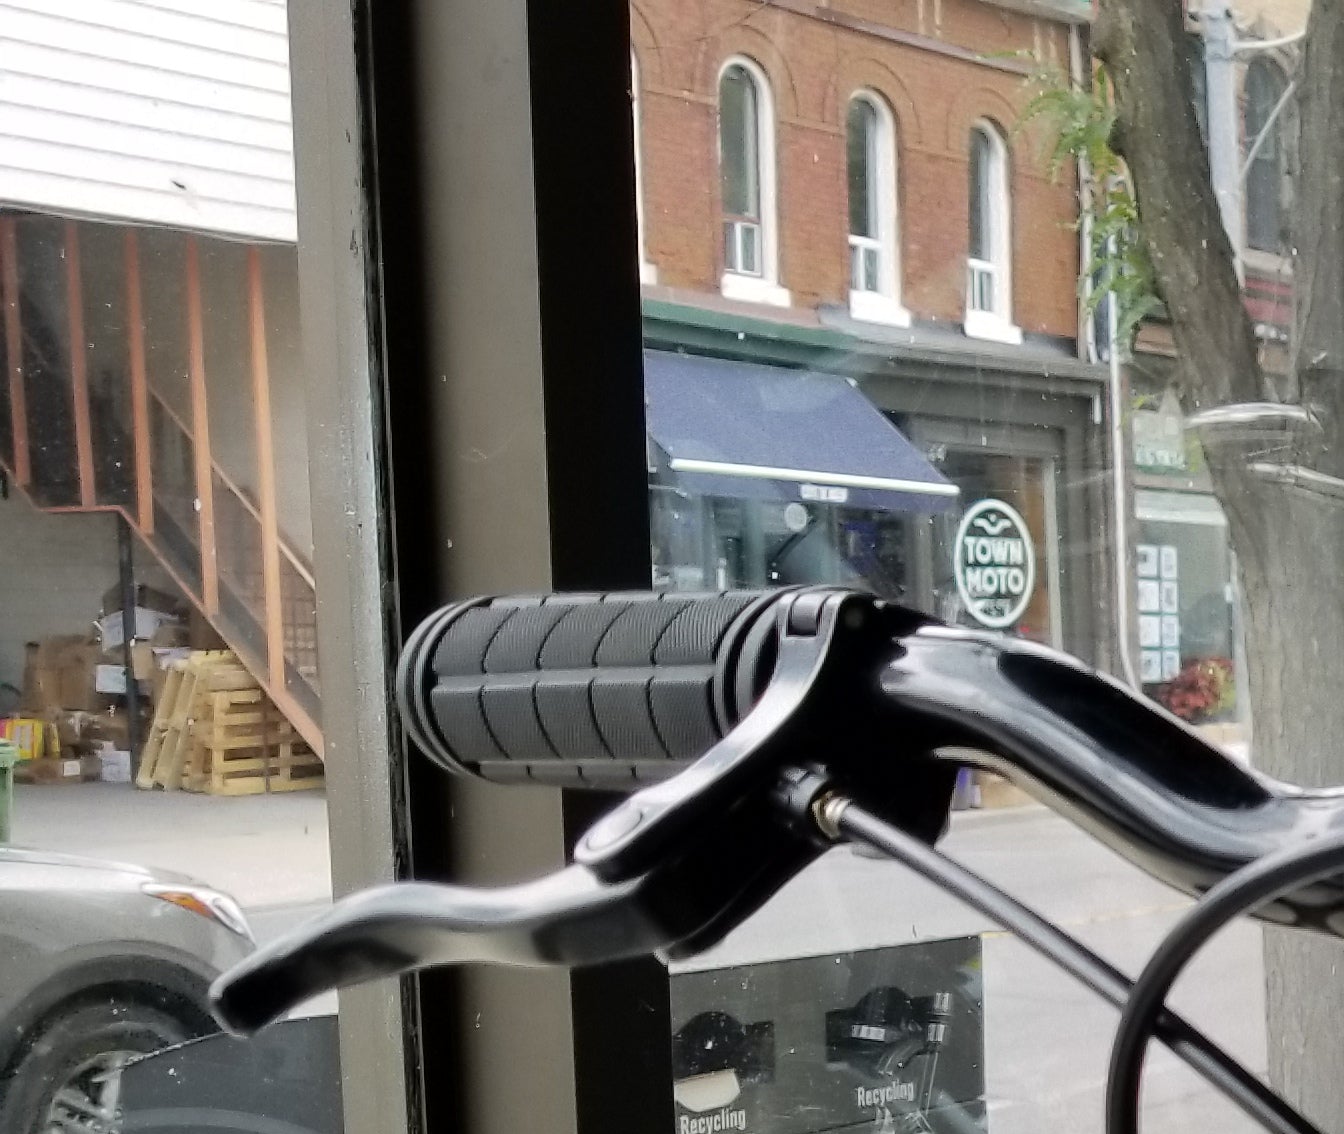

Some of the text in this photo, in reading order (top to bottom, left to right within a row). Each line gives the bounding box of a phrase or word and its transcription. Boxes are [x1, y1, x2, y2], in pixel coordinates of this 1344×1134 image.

[964, 536, 1023, 564] TOWN
[966, 567, 1024, 596] MOTO
[857, 1079, 914, 1107] Recycling
